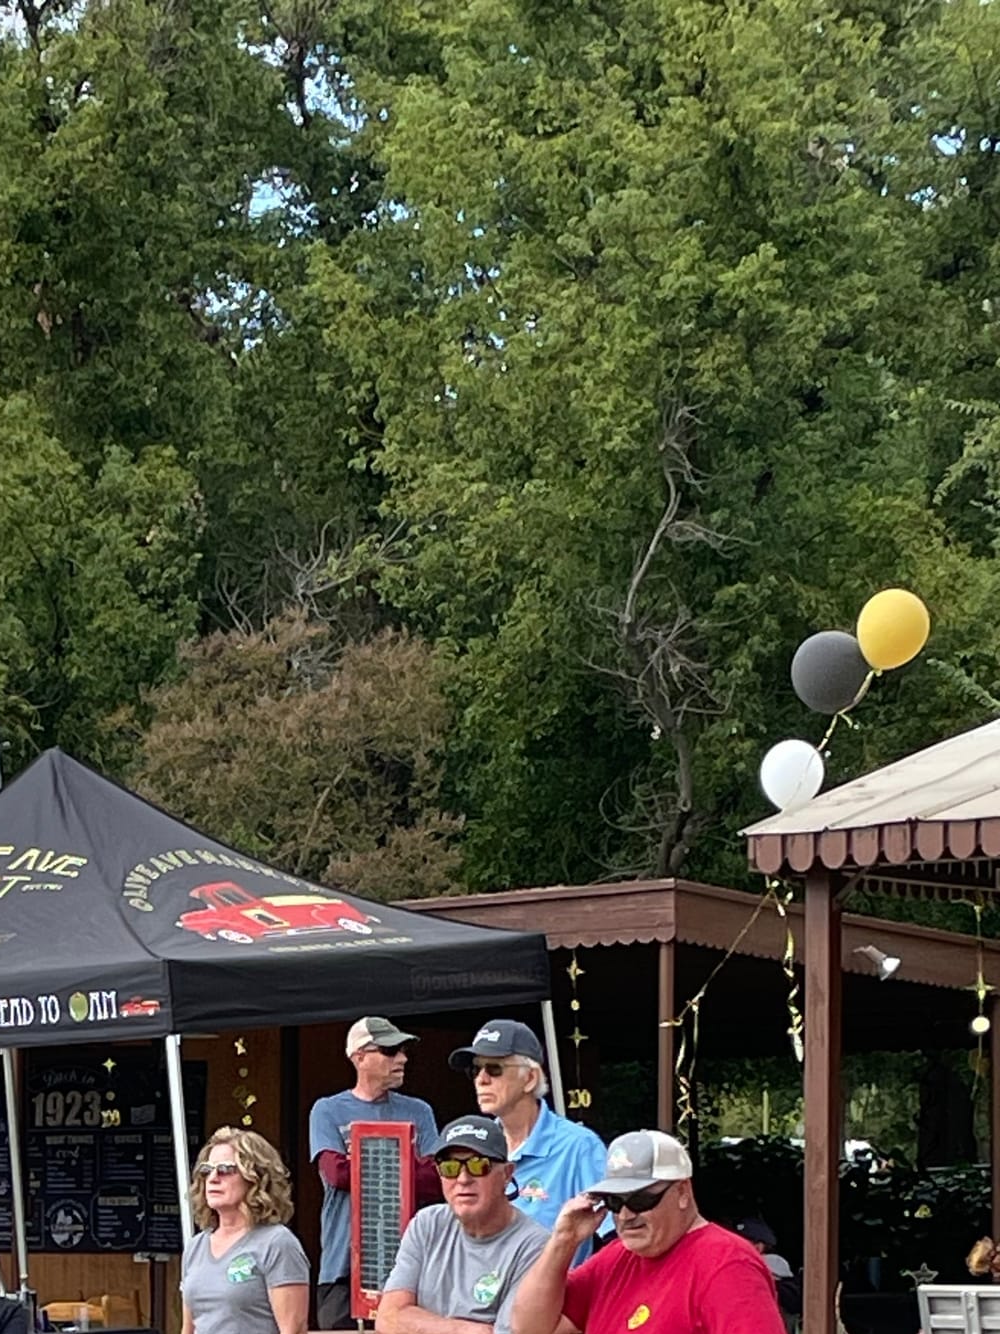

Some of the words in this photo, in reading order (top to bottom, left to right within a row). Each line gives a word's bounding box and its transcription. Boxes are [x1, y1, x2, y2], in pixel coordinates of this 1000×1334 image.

[7, 848, 88, 877] AVE
[37, 995, 61, 1026] TO
[31, 1089, 101, 1127] 1923
